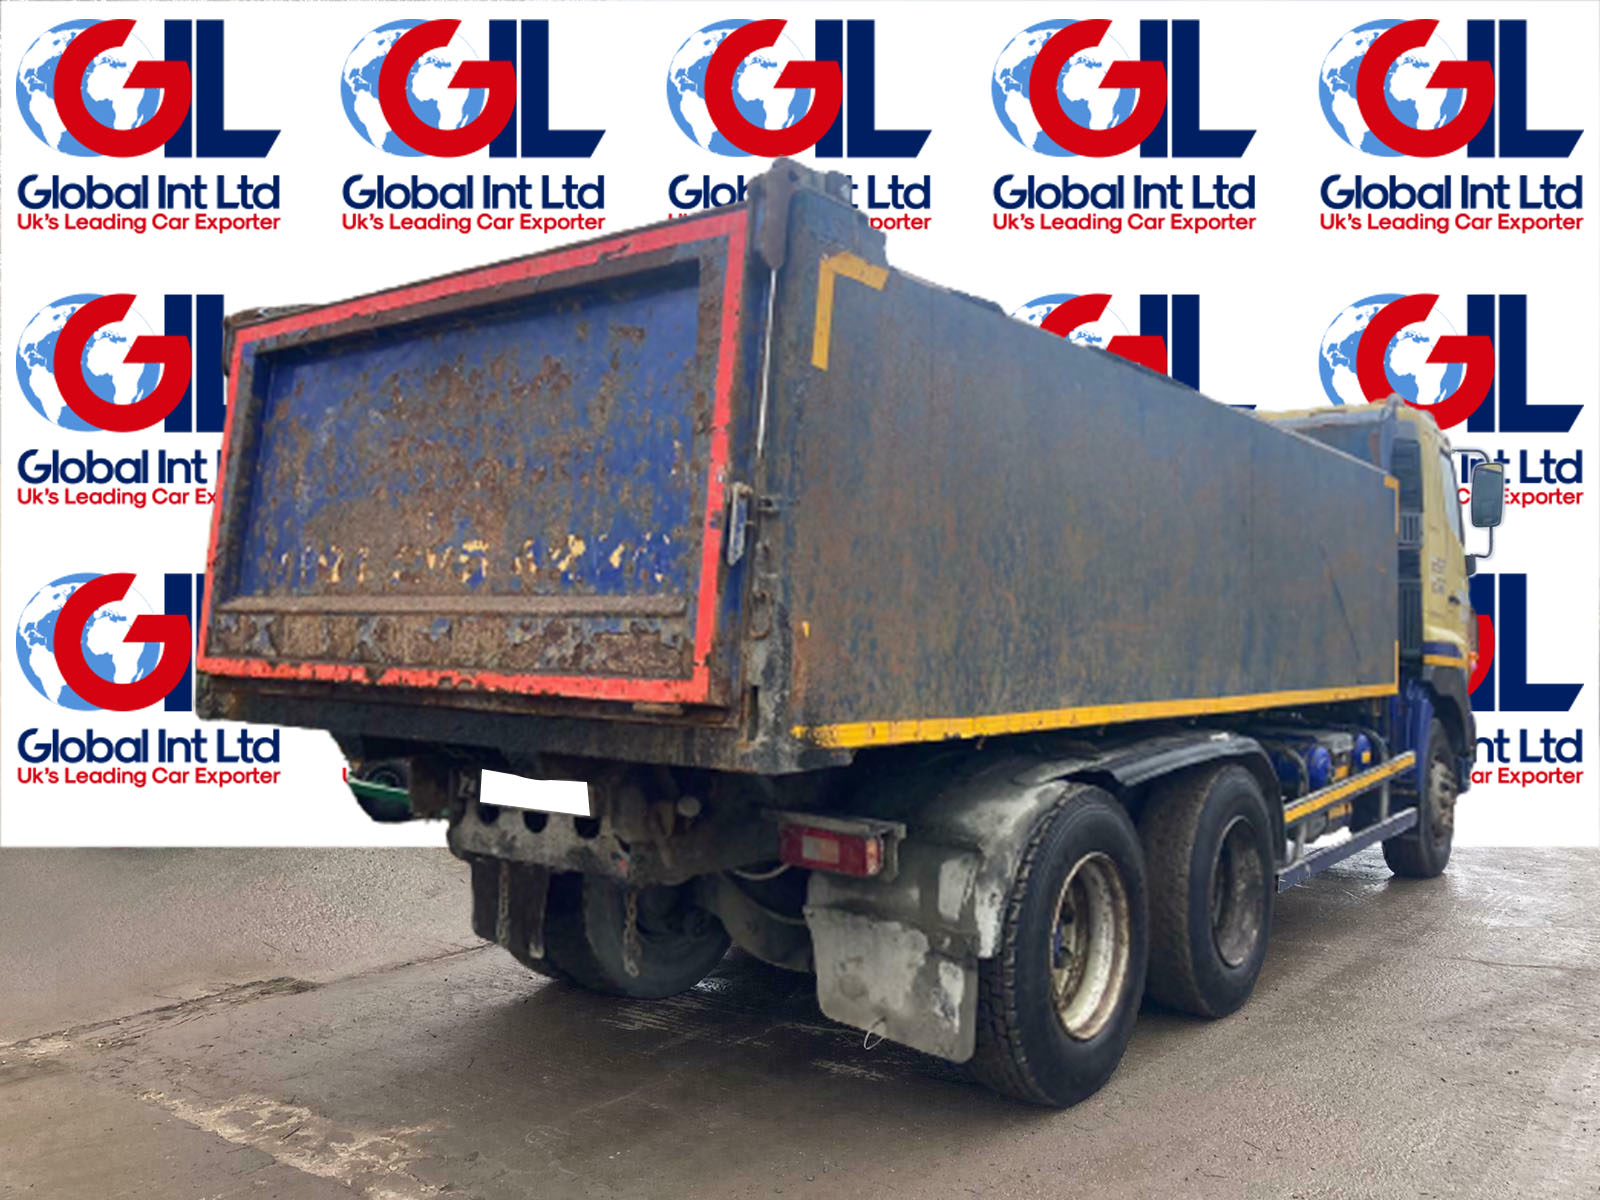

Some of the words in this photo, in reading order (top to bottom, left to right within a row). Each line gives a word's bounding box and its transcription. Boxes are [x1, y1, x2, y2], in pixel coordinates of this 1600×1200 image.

[53, 18, 281, 158] GIL
[378, 18, 606, 158] GIL
[704, 18, 932, 158] GIL
[1029, 18, 1257, 158] GIL
[1356, 18, 1584, 158] GIL
[17, 174, 149, 210] Global
[158, 174, 208, 210] Int
[217, 174, 280, 210] Ltd
[342, 174, 474, 210] Global
[483, 174, 533, 210] Int
[542, 174, 605, 210] Ltd
[867, 174, 931, 210] Ltd
[993, 174, 1125, 210] Global
[1134, 174, 1184, 210] Int
[1193, 174, 1256, 210] Ltd
[1320, 174, 1452, 210] Global
[1461, 174, 1511, 210] Int
[1520, 174, 1583, 210] Ltd
[17, 213, 60, 230] Uk's
[64, 213, 147, 234] Leading
[151, 212, 190, 230] Car
[195, 213, 281, 234] Exporter
[342, 213, 385, 230] Uk's
[389, 213, 472, 234] Leading
[476, 212, 515, 230] Car
[520, 213, 606, 234] Exporter
[869, 213, 932, 230] porter
[993, 213, 1036, 230] Uk's
[1040, 213, 1123, 234] Leading
[1127, 212, 1166, 230] Car
[1171, 213, 1257, 234] Exporter
[1320, 213, 1363, 230] Uk's
[1367, 213, 1450, 234] Leading
[1454, 212, 1493, 230] Car
[1498, 213, 1584, 234] Exporter
[1356, 293, 1584, 433] GIL
[17, 449, 149, 485] Global
[158, 449, 208, 485] Int
[1519, 449, 1583, 485] Ltd
[17, 487, 60, 505] Uk's
[64, 487, 147, 509] Leading
[151, 487, 190, 505] Car
[53, 572, 206, 712] GI
[17, 728, 149, 764] Global
[158, 728, 208, 764] Int
[217, 728, 280, 764] Ltd
[1476, 728, 1511, 764] nt
[1519, 728, 1583, 764] Ltd
[17, 767, 60, 784] Uk's
[64, 767, 147, 788] Leading
[151, 766, 190, 784] Car
[195, 767, 281, 788] Exporter
[1470, 770, 1493, 784] ar
[1497, 767, 1584, 788] Exporter
